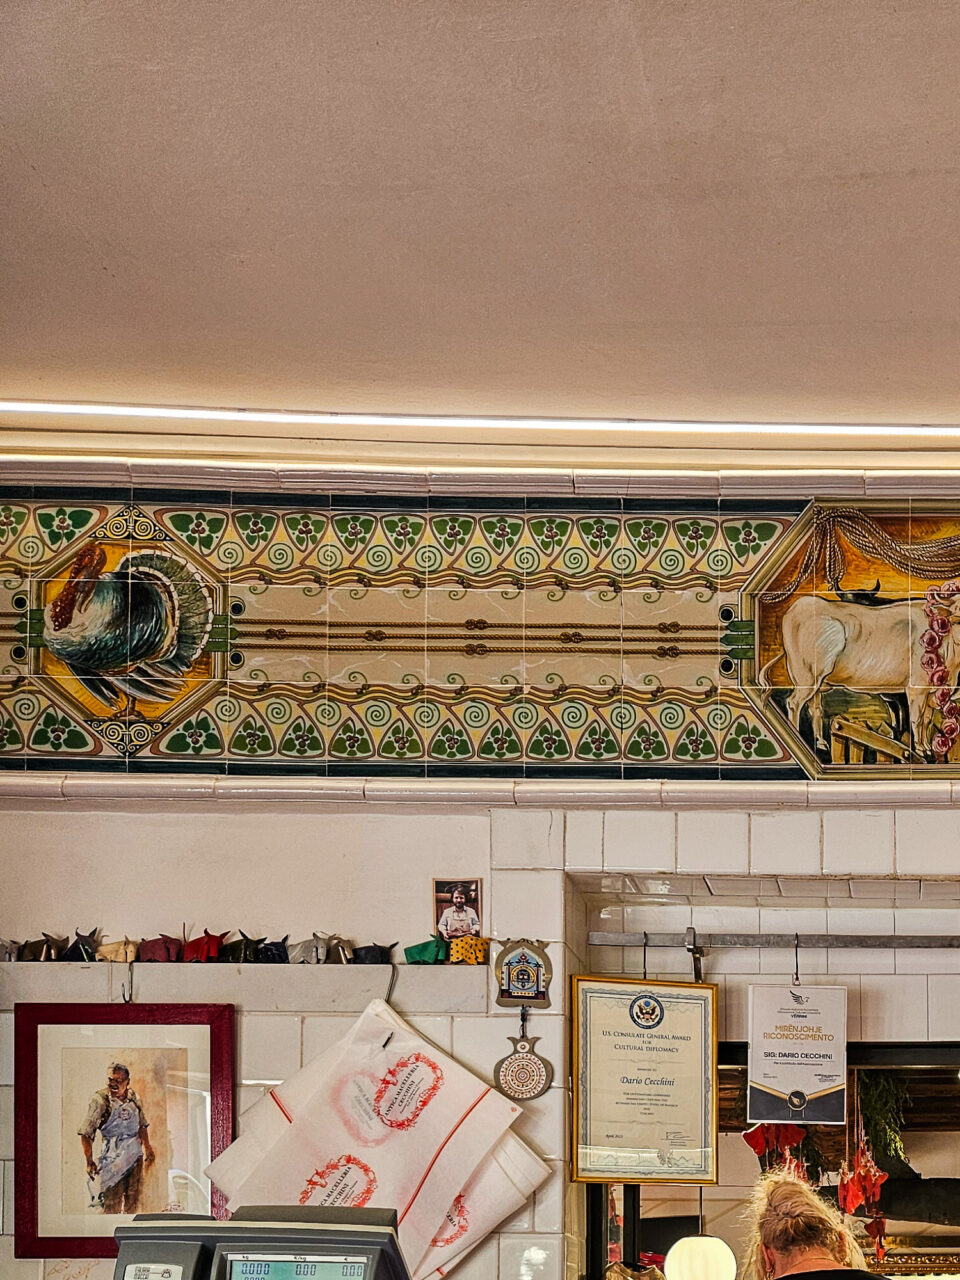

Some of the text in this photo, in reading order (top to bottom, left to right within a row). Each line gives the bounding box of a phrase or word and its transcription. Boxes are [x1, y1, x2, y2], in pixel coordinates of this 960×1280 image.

[774, 1024, 823, 1034] MIRËNJOHJE
[613, 1031, 645, 1039] CONSULATE
[763, 1032, 835, 1042] RICONOSCIMENTO
[614, 1044, 679, 1053] CULTURAL DIPLOMACY
[396, 1065, 420, 1099] MACELLERIA
[620, 1076, 675, 1087] Dario Cecchini
[397, 1080, 416, 1107] CECCHINI
[326, 1166, 352, 1199] MACELLERIA
[295, 1264, 316, 1276] 0.00
